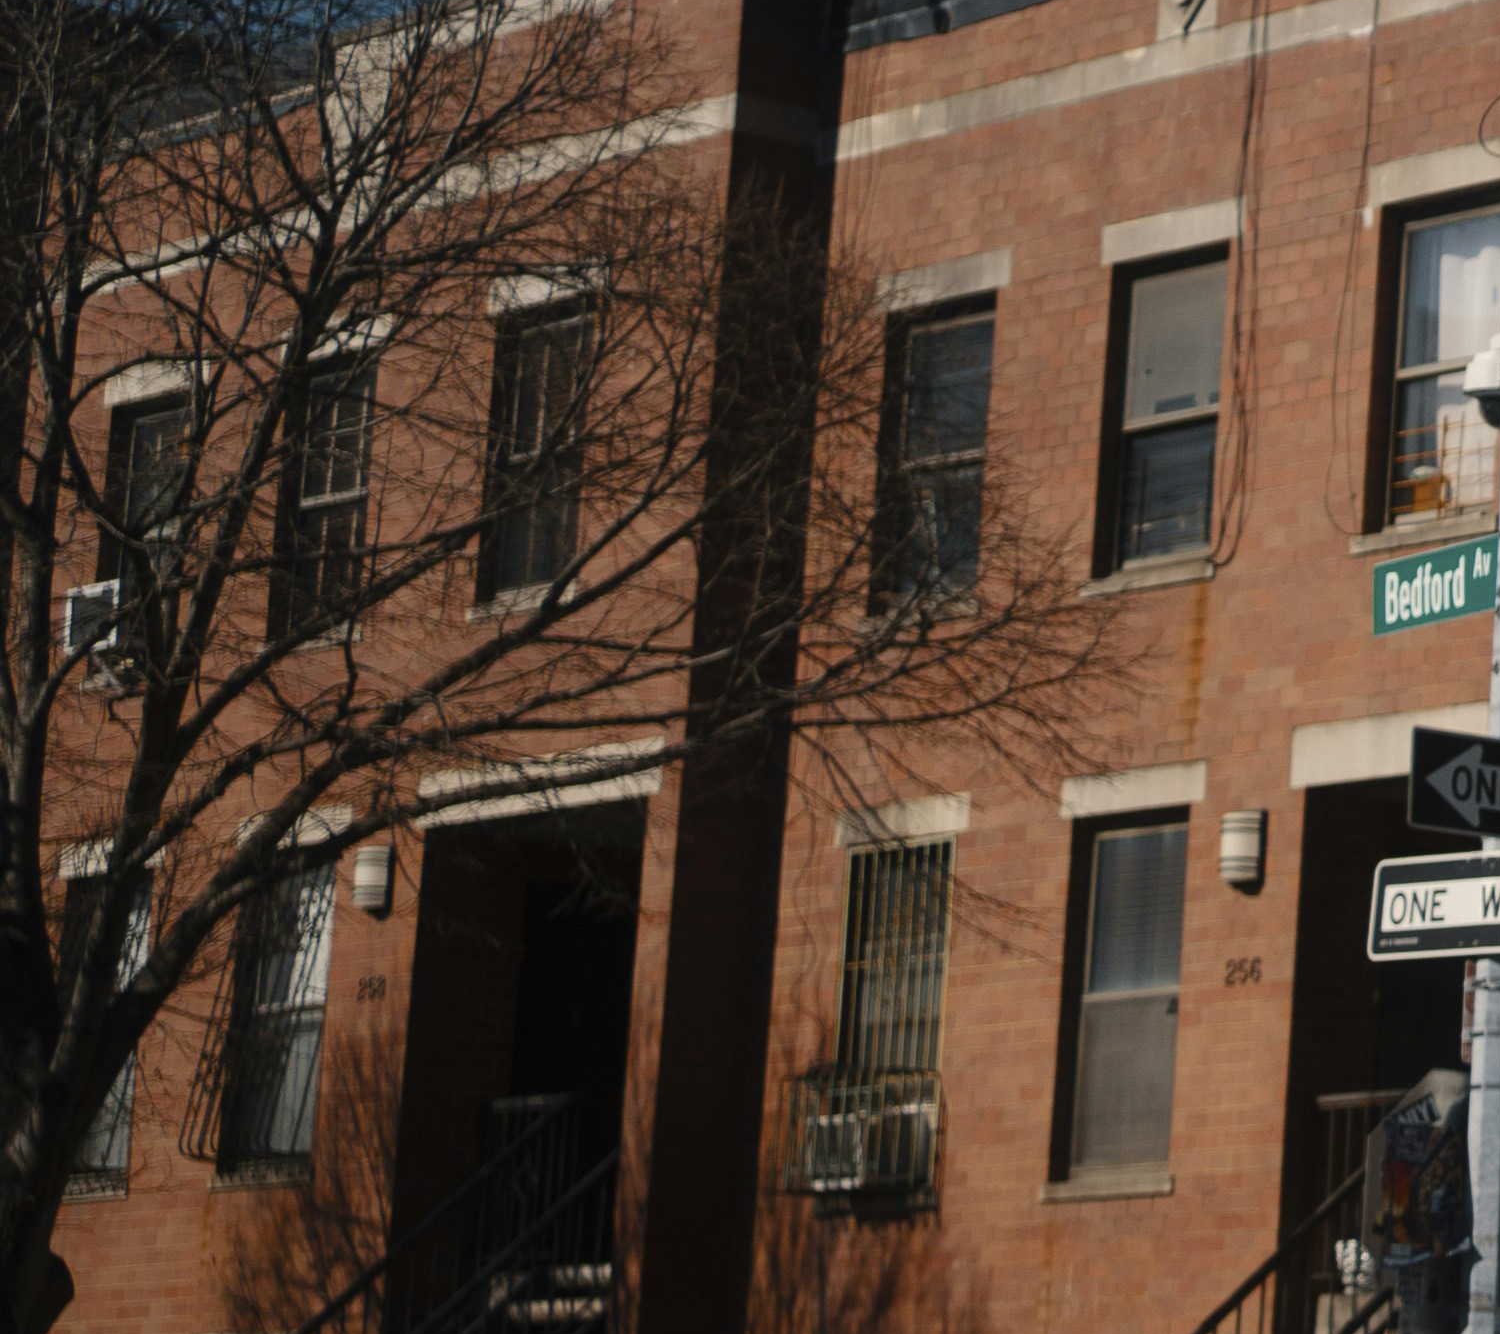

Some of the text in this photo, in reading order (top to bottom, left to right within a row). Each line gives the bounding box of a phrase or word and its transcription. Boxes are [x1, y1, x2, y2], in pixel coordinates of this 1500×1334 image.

[1384, 546, 1491, 625] Bedford Av
[1389, 887, 1448, 926] ONE
[1223, 956, 1263, 988] 256
